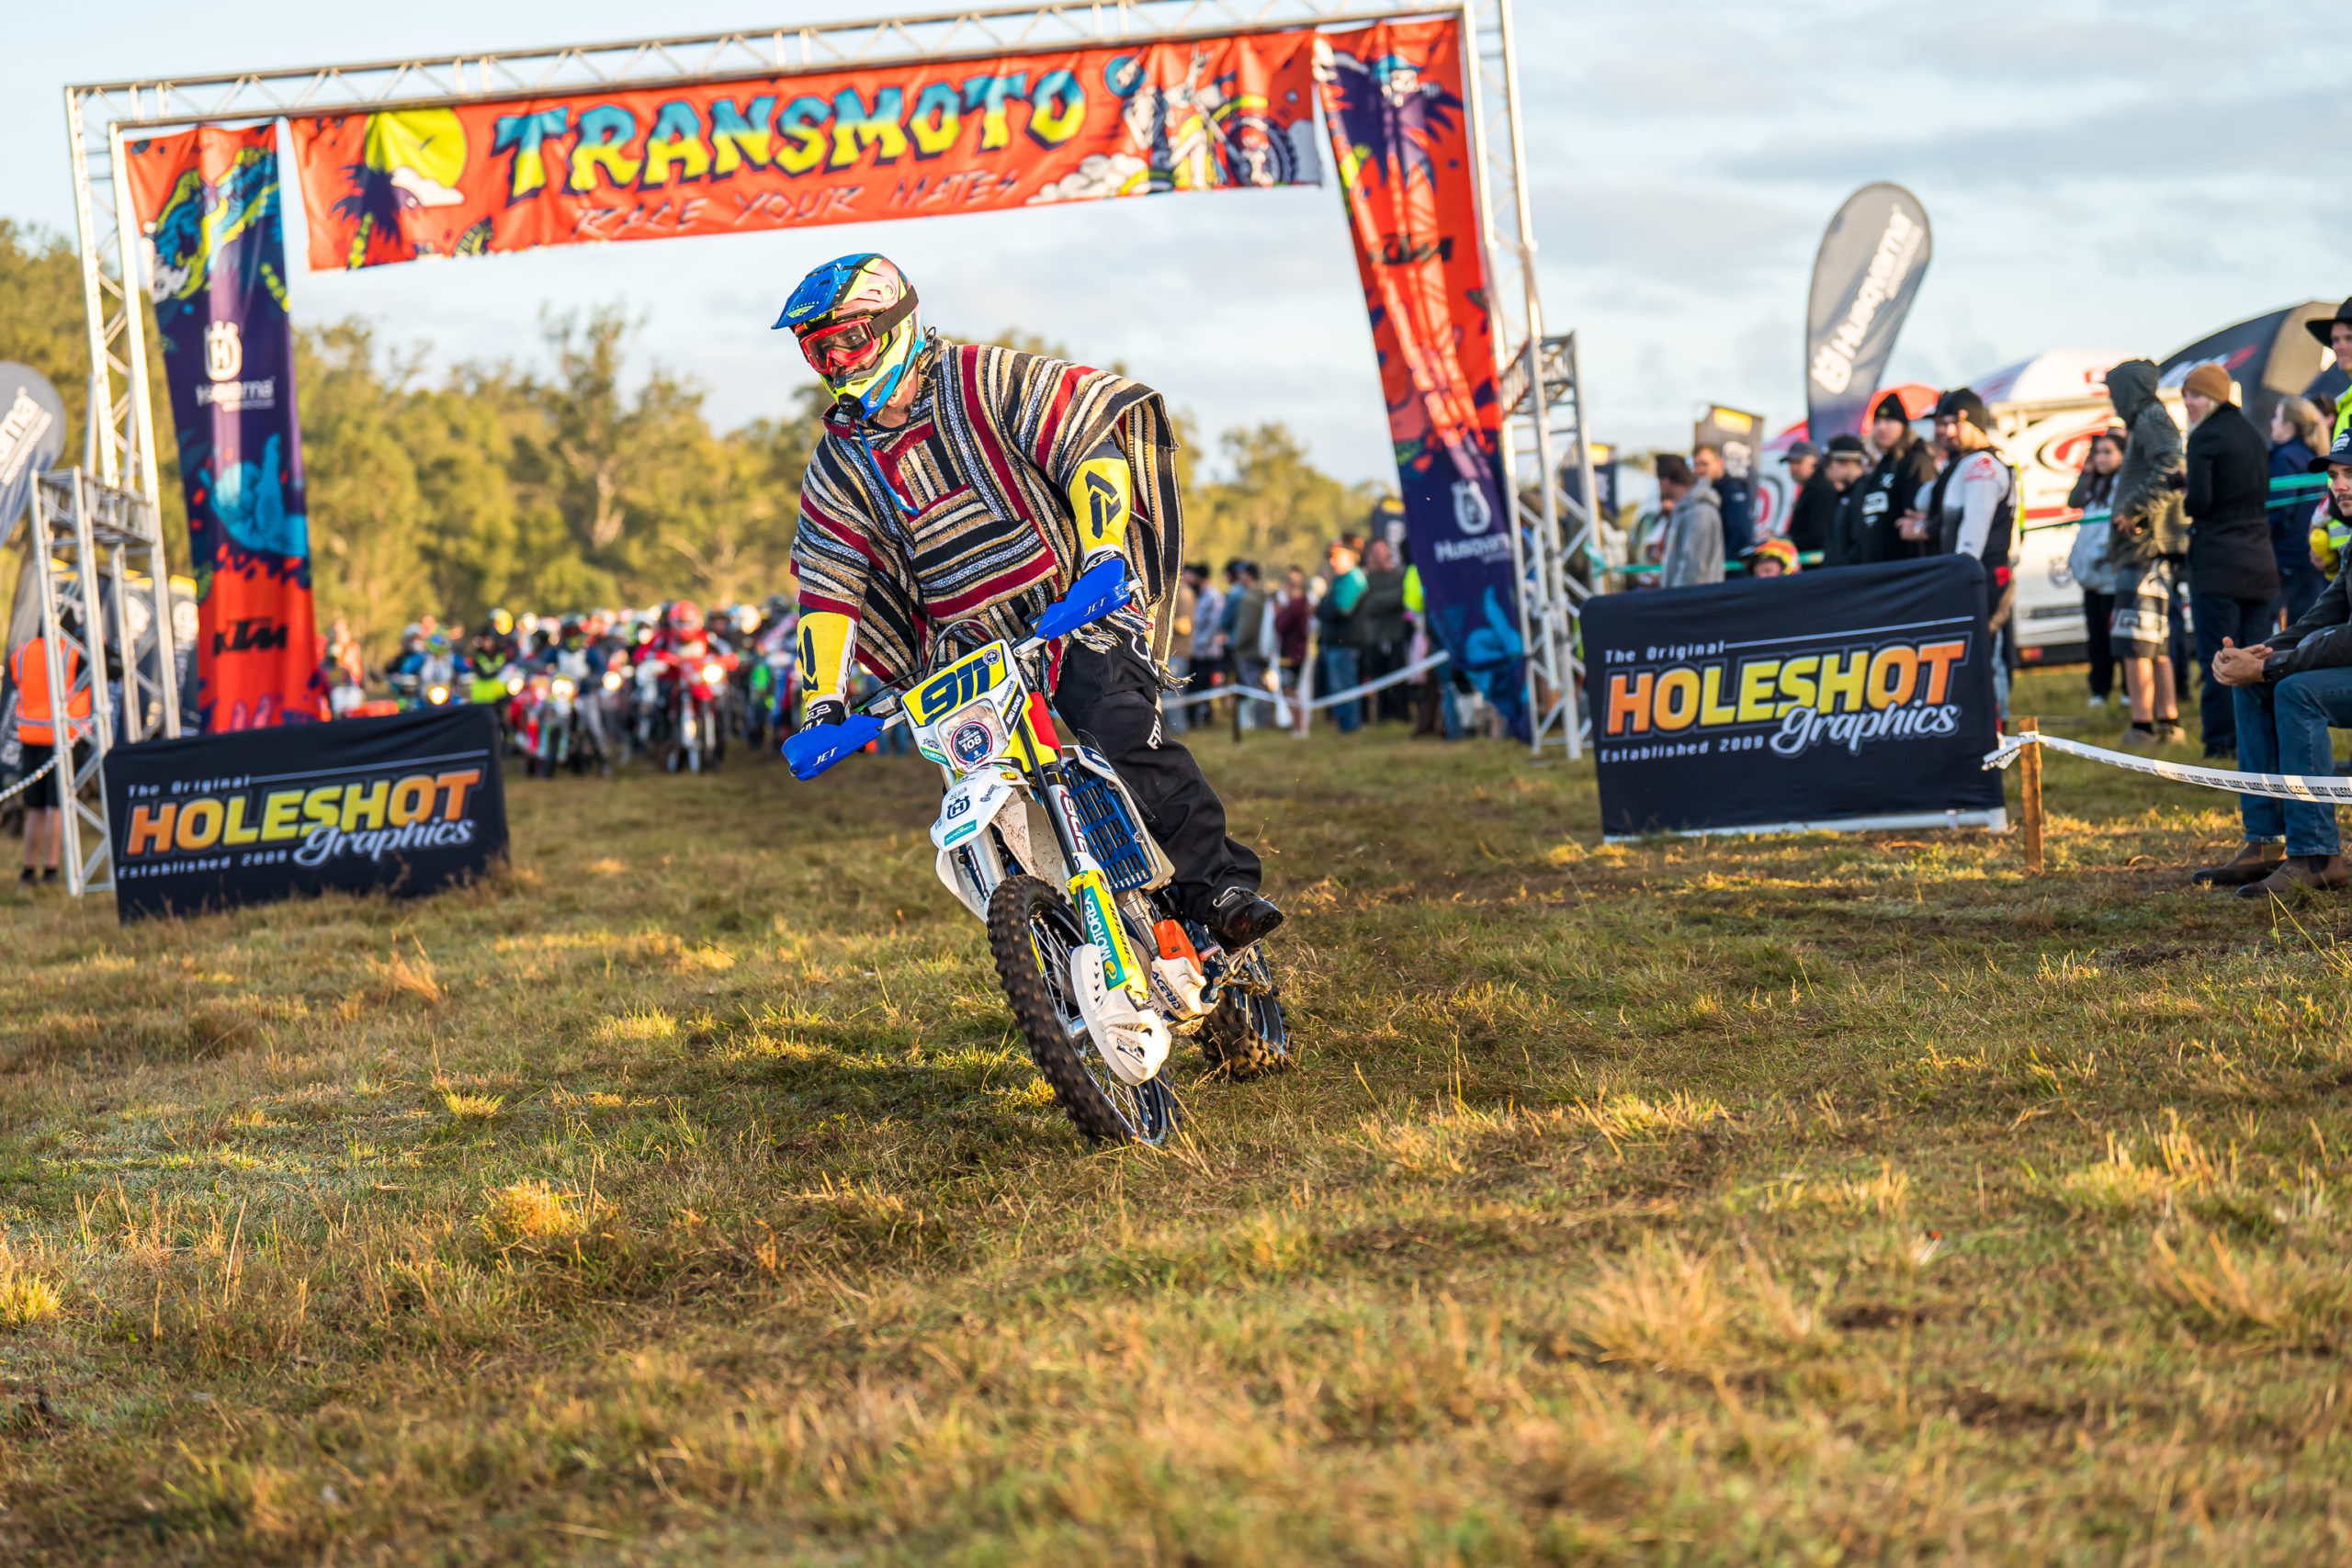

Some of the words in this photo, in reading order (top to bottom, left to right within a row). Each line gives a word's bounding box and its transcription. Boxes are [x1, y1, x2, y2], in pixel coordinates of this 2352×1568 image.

[490, 70, 1086, 209] TRANSMOTO
[573, 197, 708, 235] RACE
[735, 186, 865, 226] YOUR
[888, 169, 1020, 209] MATES
[1831, 211, 1913, 359] Husqvarna
[1083, 596, 1107, 617] JET
[212, 615, 288, 657] KTM
[1604, 649, 1636, 663] The
[1645, 639, 1724, 661] Original
[921, 656, 991, 726] 911
[1607, 640, 1965, 735] HOLESHOT
[961, 735, 982, 752] 108
[1600, 739, 1710, 763] Established
[1718, 735, 1764, 752] 2009
[1770, 698, 1959, 754] graphics
[812, 746, 839, 767] JET
[127, 784, 161, 798] The
[171, 773, 251, 795] Original
[127, 769, 481, 856] HOLESHOT
[293, 816, 474, 866] graphics
[118, 855, 232, 880] Established
[1084, 894, 1113, 963] MOTOREX
[1108, 902, 1131, 958] DUNLOP
[1151, 970, 1182, 1010] ACERBIS
